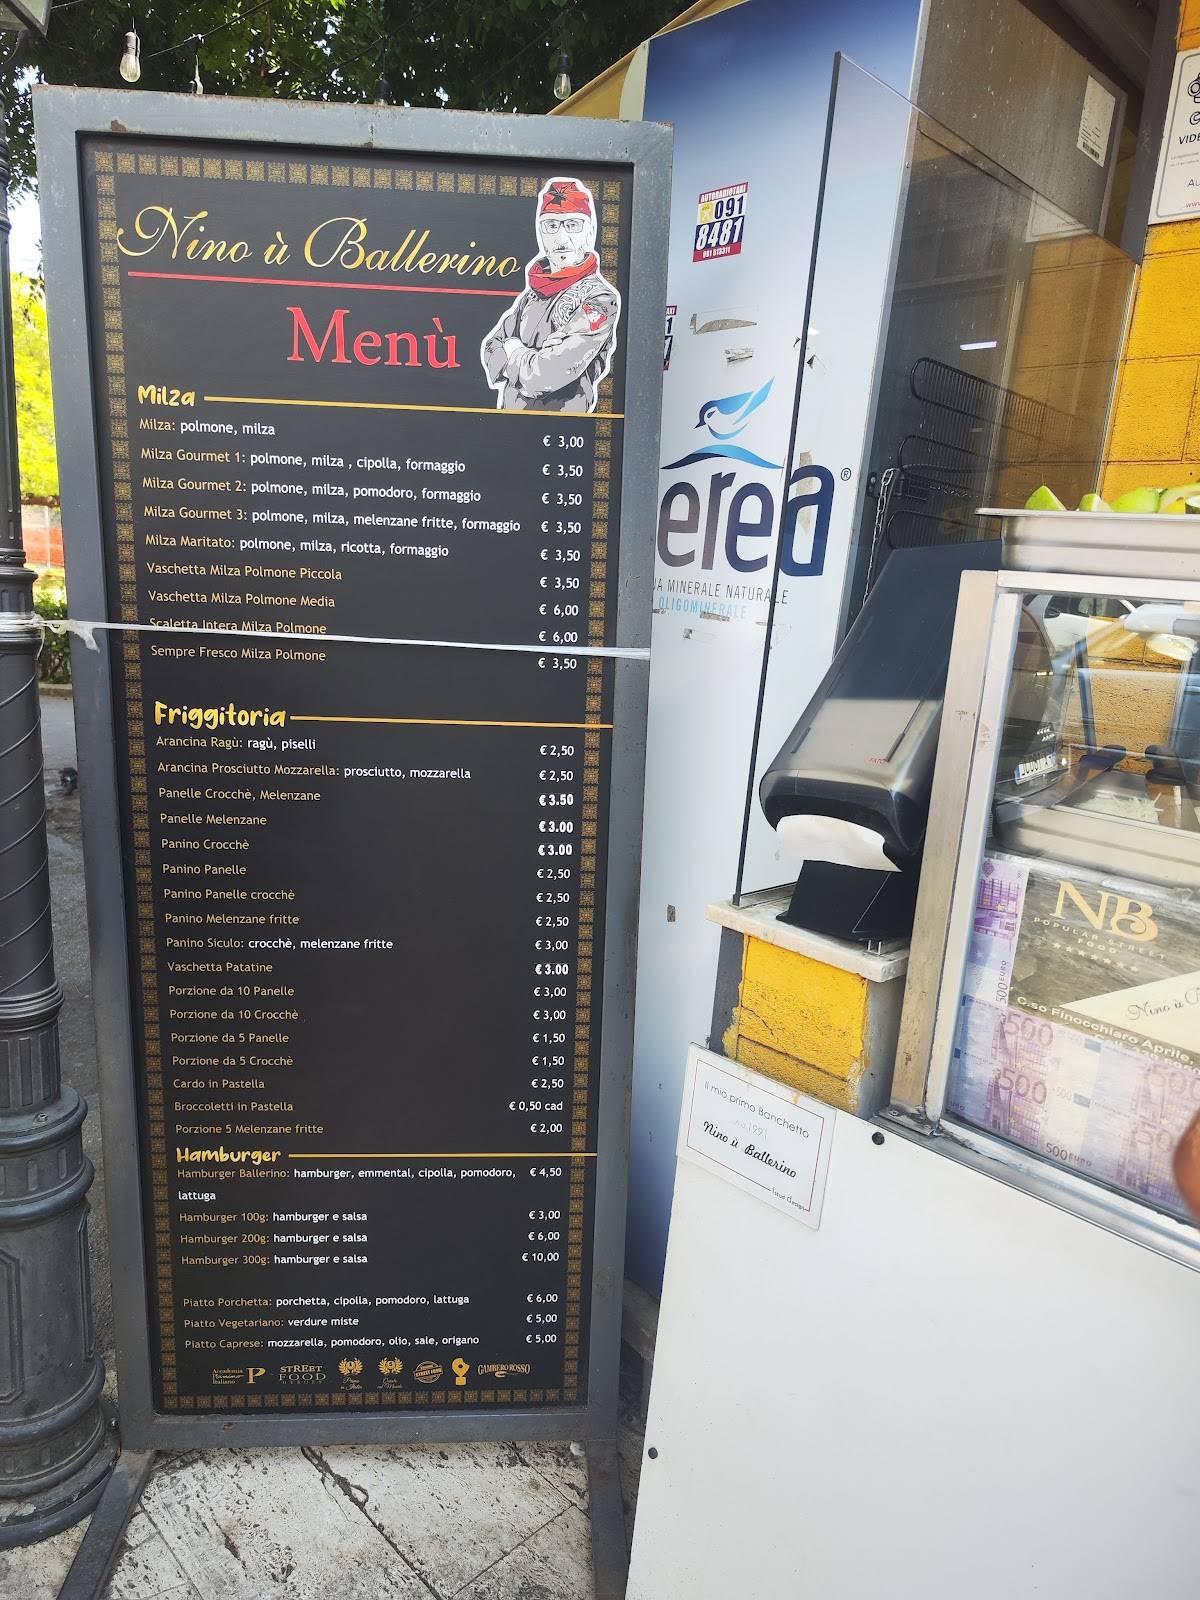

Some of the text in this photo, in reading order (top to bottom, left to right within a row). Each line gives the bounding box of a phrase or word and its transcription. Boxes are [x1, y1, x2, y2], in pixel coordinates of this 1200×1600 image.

[714, 195, 744, 220] 091
[116, 206, 521, 277] Nino ù Ballerino
[696, 217, 744, 251] 8481
[286, 307, 461, 368] Menù
[137, 384, 196, 407] Milza
[139, 417, 276, 436] Milza: polmone, milza
[542, 434, 584, 450] € 3,00
[140, 447, 466, 475] Milza Gourmet 1: polmone, milza cipolla, formaggio
[542, 463, 584, 479] € 3,50
[143, 505, 521, 534] Milza Gourmet 3: polmone, milza, melenzane fritte, formaggio
[540, 520, 582, 535] € 3,50
[145, 534, 449, 559] Milza Maritato: polmone, milza, ricotta, formaggio
[146, 562, 343, 580] Vaschetta Milza Polmone Piccola
[667, 579, 721, 598] MINERALE
[155, 701, 286, 730] Friggitoria
[156, 735, 316, 752] Arancina Ragù: ragù, piselli
[539, 744, 575, 758] € 2,50
[157, 762, 472, 779] Arancina Prosciutto Mozzarella: prosciutto, mozzarella
[158, 787, 321, 801] Panelle Crocchè, Melenzane
[538, 793, 574, 807] € 3.50
[162, 863, 247, 875] Panino Panelle
[1049, 880, 1158, 942] NB
[1033, 917, 1098, 941] POPULAR
[166, 937, 394, 951] Panino Siculo: crocchè, melenzane fritte
[167, 961, 273, 973] Vaschetta Patatine
[534, 963, 569, 975] € 3.00
[168, 985, 295, 997] Porzione da 10 Panelle
[1125, 1000, 1171, 1021] Nino
[1004, 1012, 1054, 1048] 500
[1051, 1007, 1139, 1045] Finocchiaro
[1141, 1037, 1194, 1065] Aprile,
[999, 1067, 1047, 1105] 500
[174, 1101, 294, 1112] Broccoletti in Pastella
[508, 1100, 563, 1113] € 0,50 cad
[704, 1080, 710, 1090] Il
[710, 1083, 728, 1100] mio
[729, 1093, 756, 1113] primo
[758, 1107, 810, 1139] Banchetto
[175, 1123, 324, 1134] Porzione 5 Melenzane fritte
[176, 1146, 281, 1165] Hamburger
[703, 1121, 729, 1143] Nino
[729, 1136, 739, 1149] ù
[744, 1143, 797, 1178] Ballerino
[1045, 1142, 1093, 1167] 500 EURO
[177, 1167, 516, 1180] Hamburger Ballerino: hamburger, emmental, cipolla, pomodoro,
[529, 1167, 562, 1179] € 4,50
[178, 1190, 217, 1202] lattuga
[179, 1211, 368, 1224] Hamburger 100g: hamburger e salsa
[183, 1294, 470, 1308] Piatto Porchetta: porchetta, cipolla, pomodoro, lattuga
[185, 1335, 480, 1350] Piatto Caprese: mozzarella, pomodoro, olio, sale, origano
[525, 1333, 557, 1344] € 5,00
[280, 1364, 323, 1373] STREET
[509, 1363, 531, 1374] ROSSO
[279, 1373, 326, 1381] FOOD
